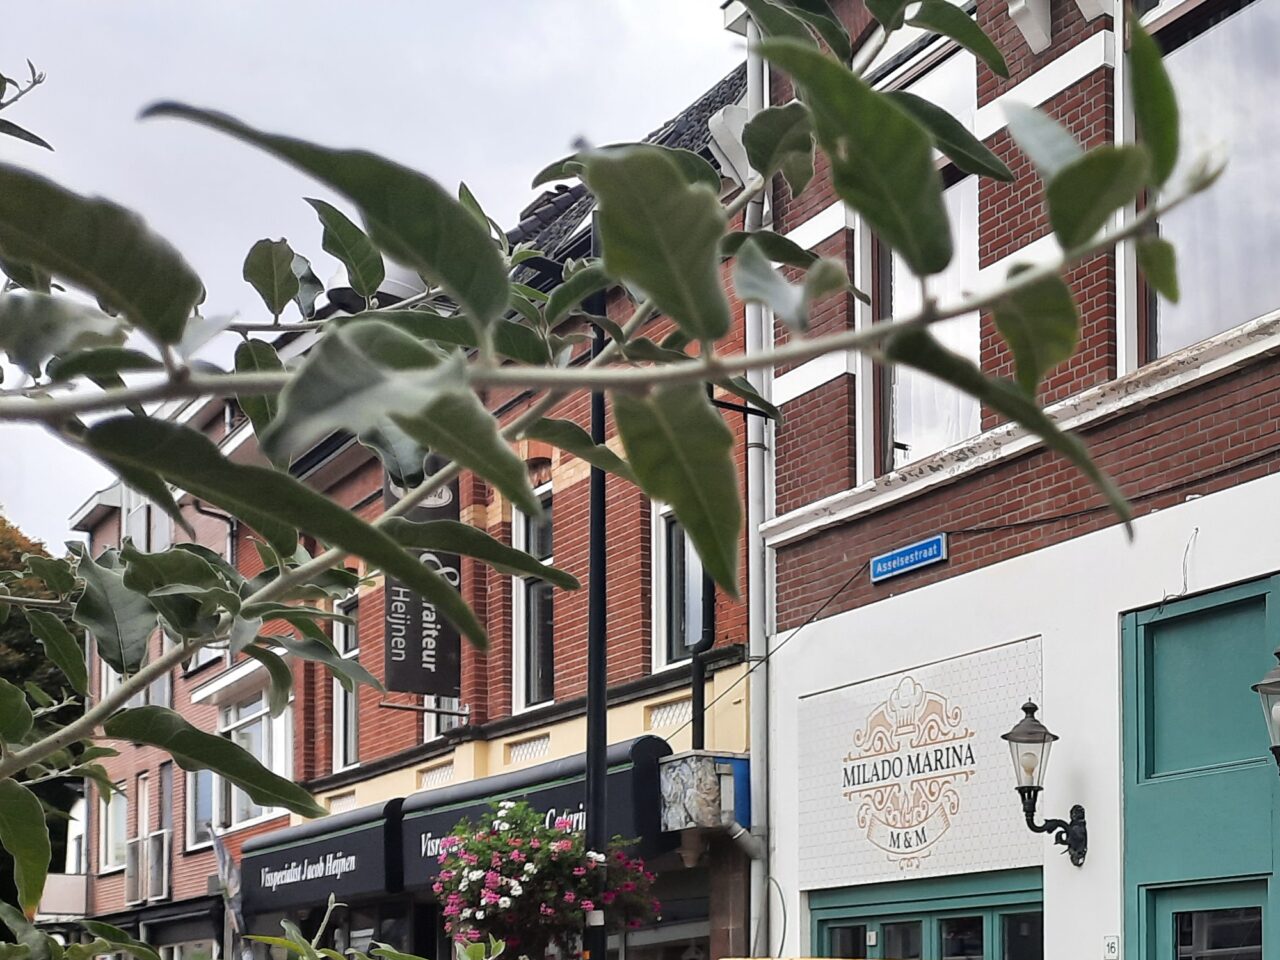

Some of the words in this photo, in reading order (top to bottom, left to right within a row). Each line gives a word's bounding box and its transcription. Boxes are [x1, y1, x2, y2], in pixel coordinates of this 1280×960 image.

[876, 543, 938, 574] Asselsestraat
[387, 587, 411, 661] Heijnen
[421, 595, 441, 672] raiteur
[842, 757, 903, 788] MILADO
[906, 743, 976, 776] MARINA
[888, 830, 901, 849] M
[903, 830, 912, 849] &
[915, 826, 927, 847] M
[261, 863, 301, 892] Visspecialist
[302, 856, 324, 880] Jacob
[325, 852, 356, 879] Heijnen
[1106, 942, 1116, 954] 16
